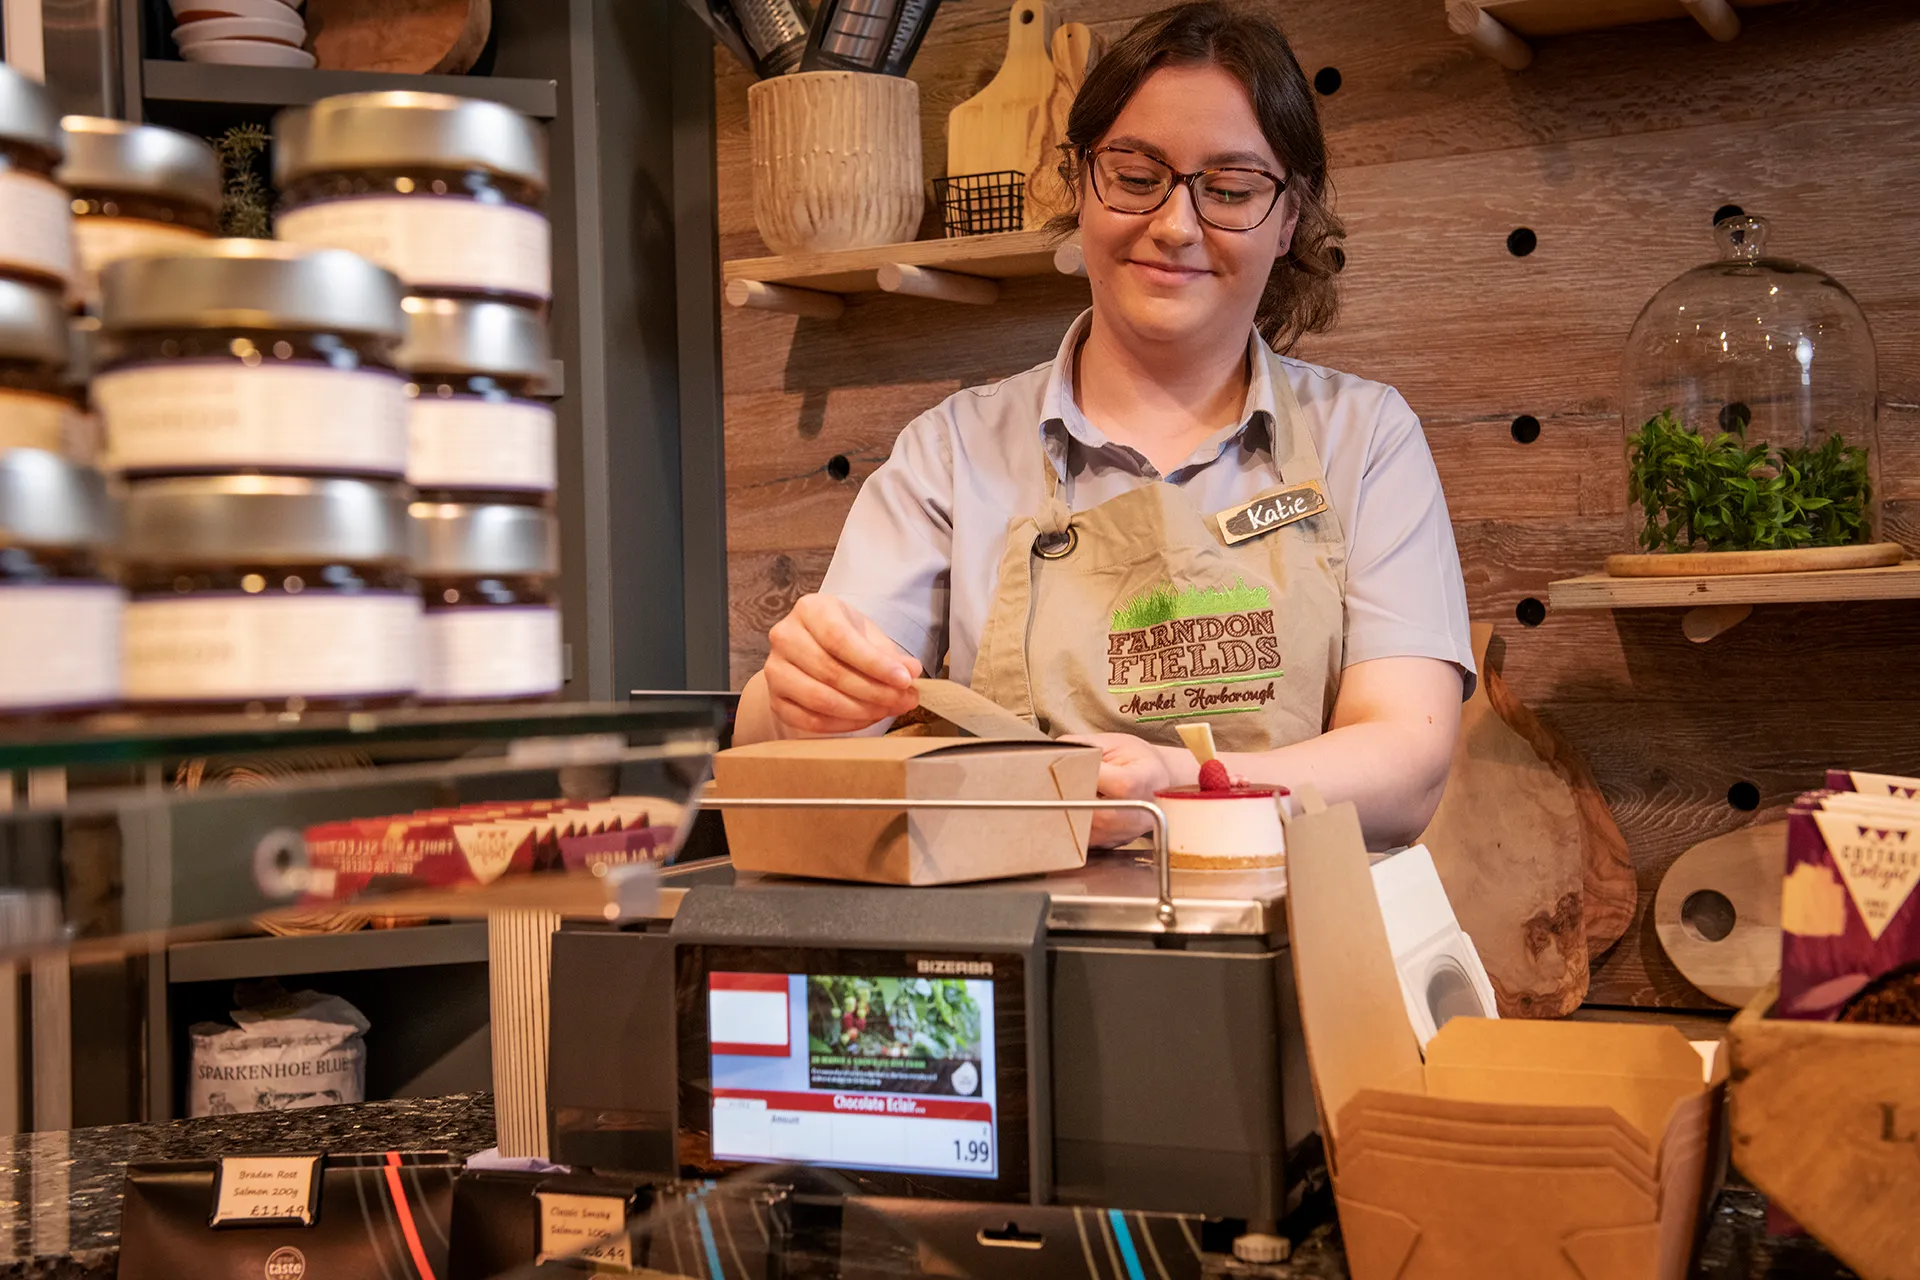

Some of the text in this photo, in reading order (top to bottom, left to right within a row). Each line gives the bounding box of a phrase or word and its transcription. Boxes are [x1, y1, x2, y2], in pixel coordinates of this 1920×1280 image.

[1246, 495, 1308, 530] Katie
[1107, 609, 1275, 656] FARNDON
[1107, 636, 1282, 686] FIELDS
[1119, 681, 1276, 715] Market Harborough
[199, 1057, 350, 1081] SPARKENHOE BLUE
[833, 1093, 885, 1112] Chocolate
[954, 1139, 989, 1163] 1.99
[239, 1170, 274, 1180] Bradan
[233, 1187, 269, 1197] Salmon
[249, 1205, 305, 1218] £11.49
[269, 1263, 302, 1275] taste
